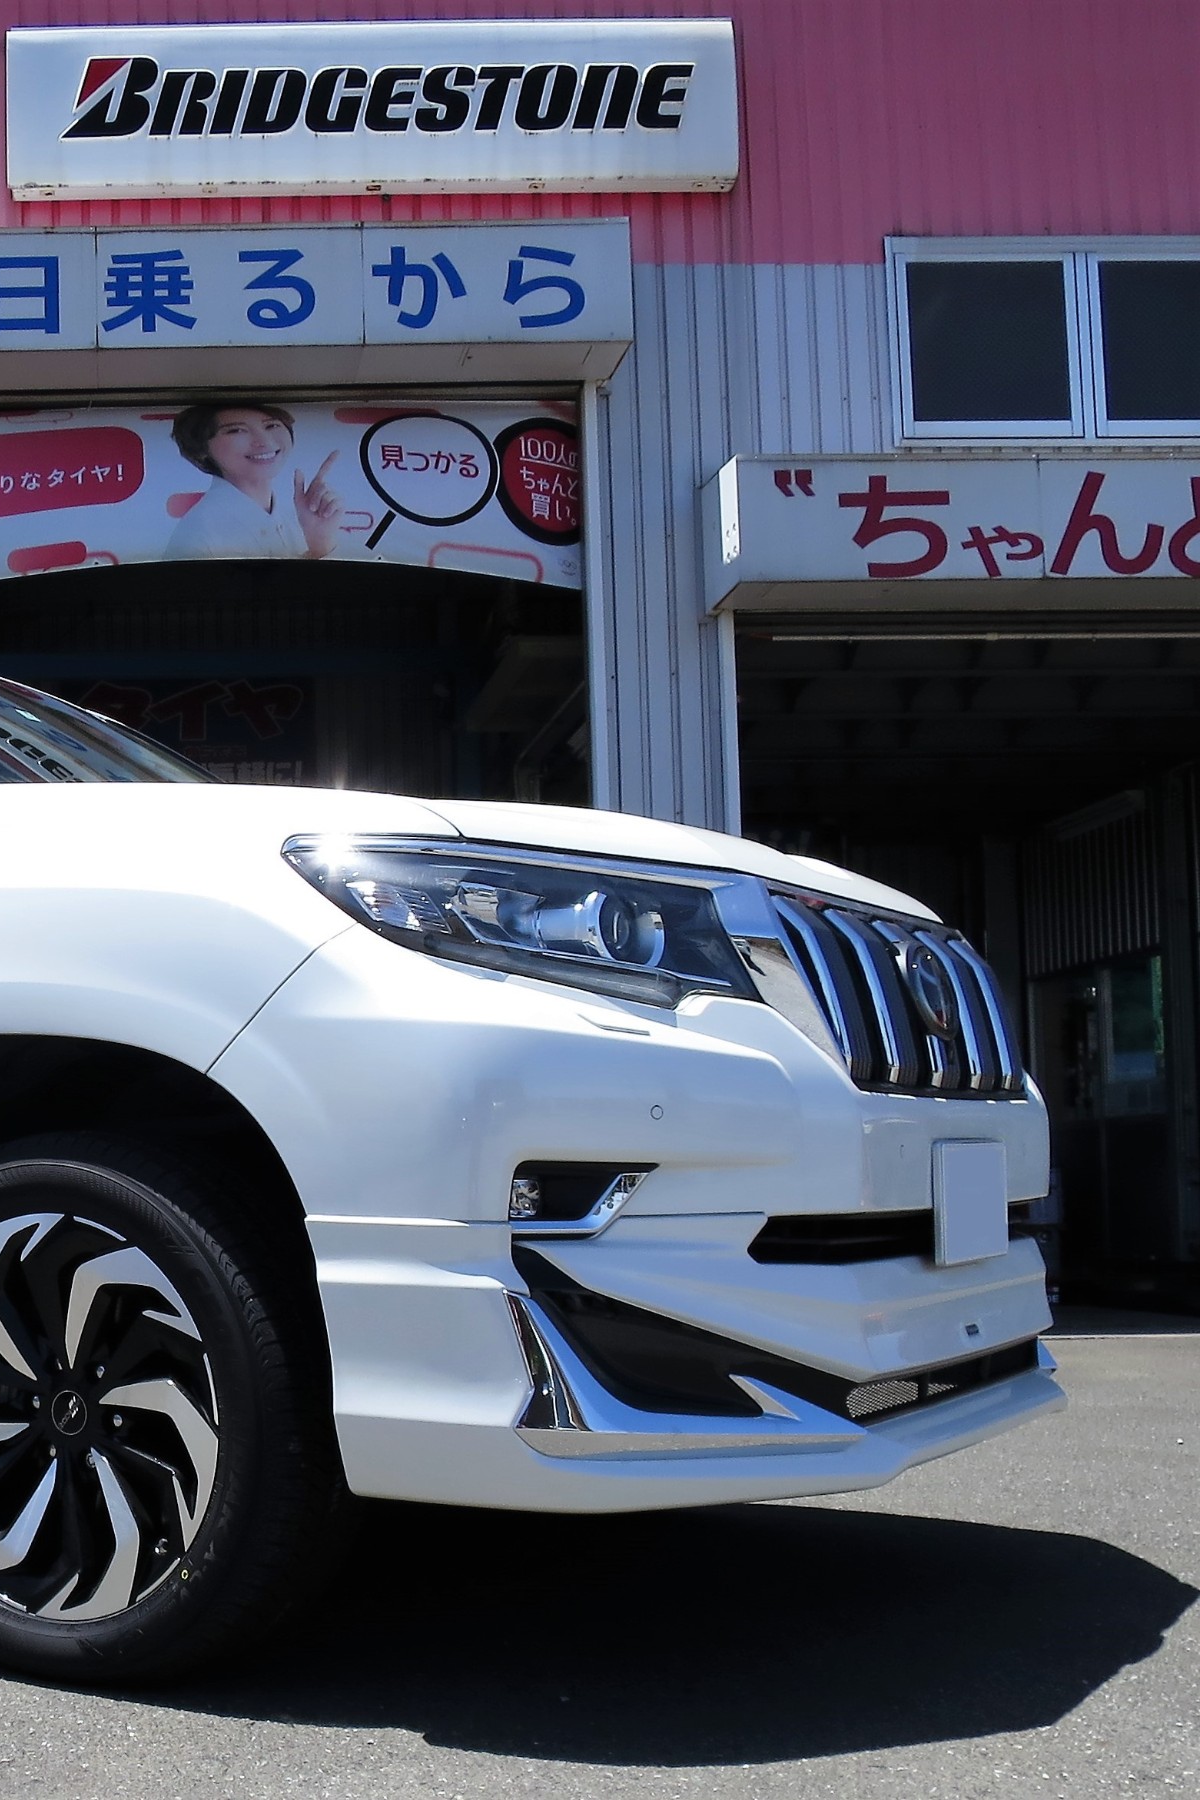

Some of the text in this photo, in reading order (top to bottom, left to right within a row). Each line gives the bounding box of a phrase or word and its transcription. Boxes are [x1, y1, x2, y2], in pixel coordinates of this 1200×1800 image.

[61, 56, 695, 140] BRIDGESTONE
[380, 444, 480, 479] 見つかる
[519, 465, 579, 501] ちゃんと
[531, 492, 577, 527] 買い。
[79, 678, 305, 741] タイヤ
